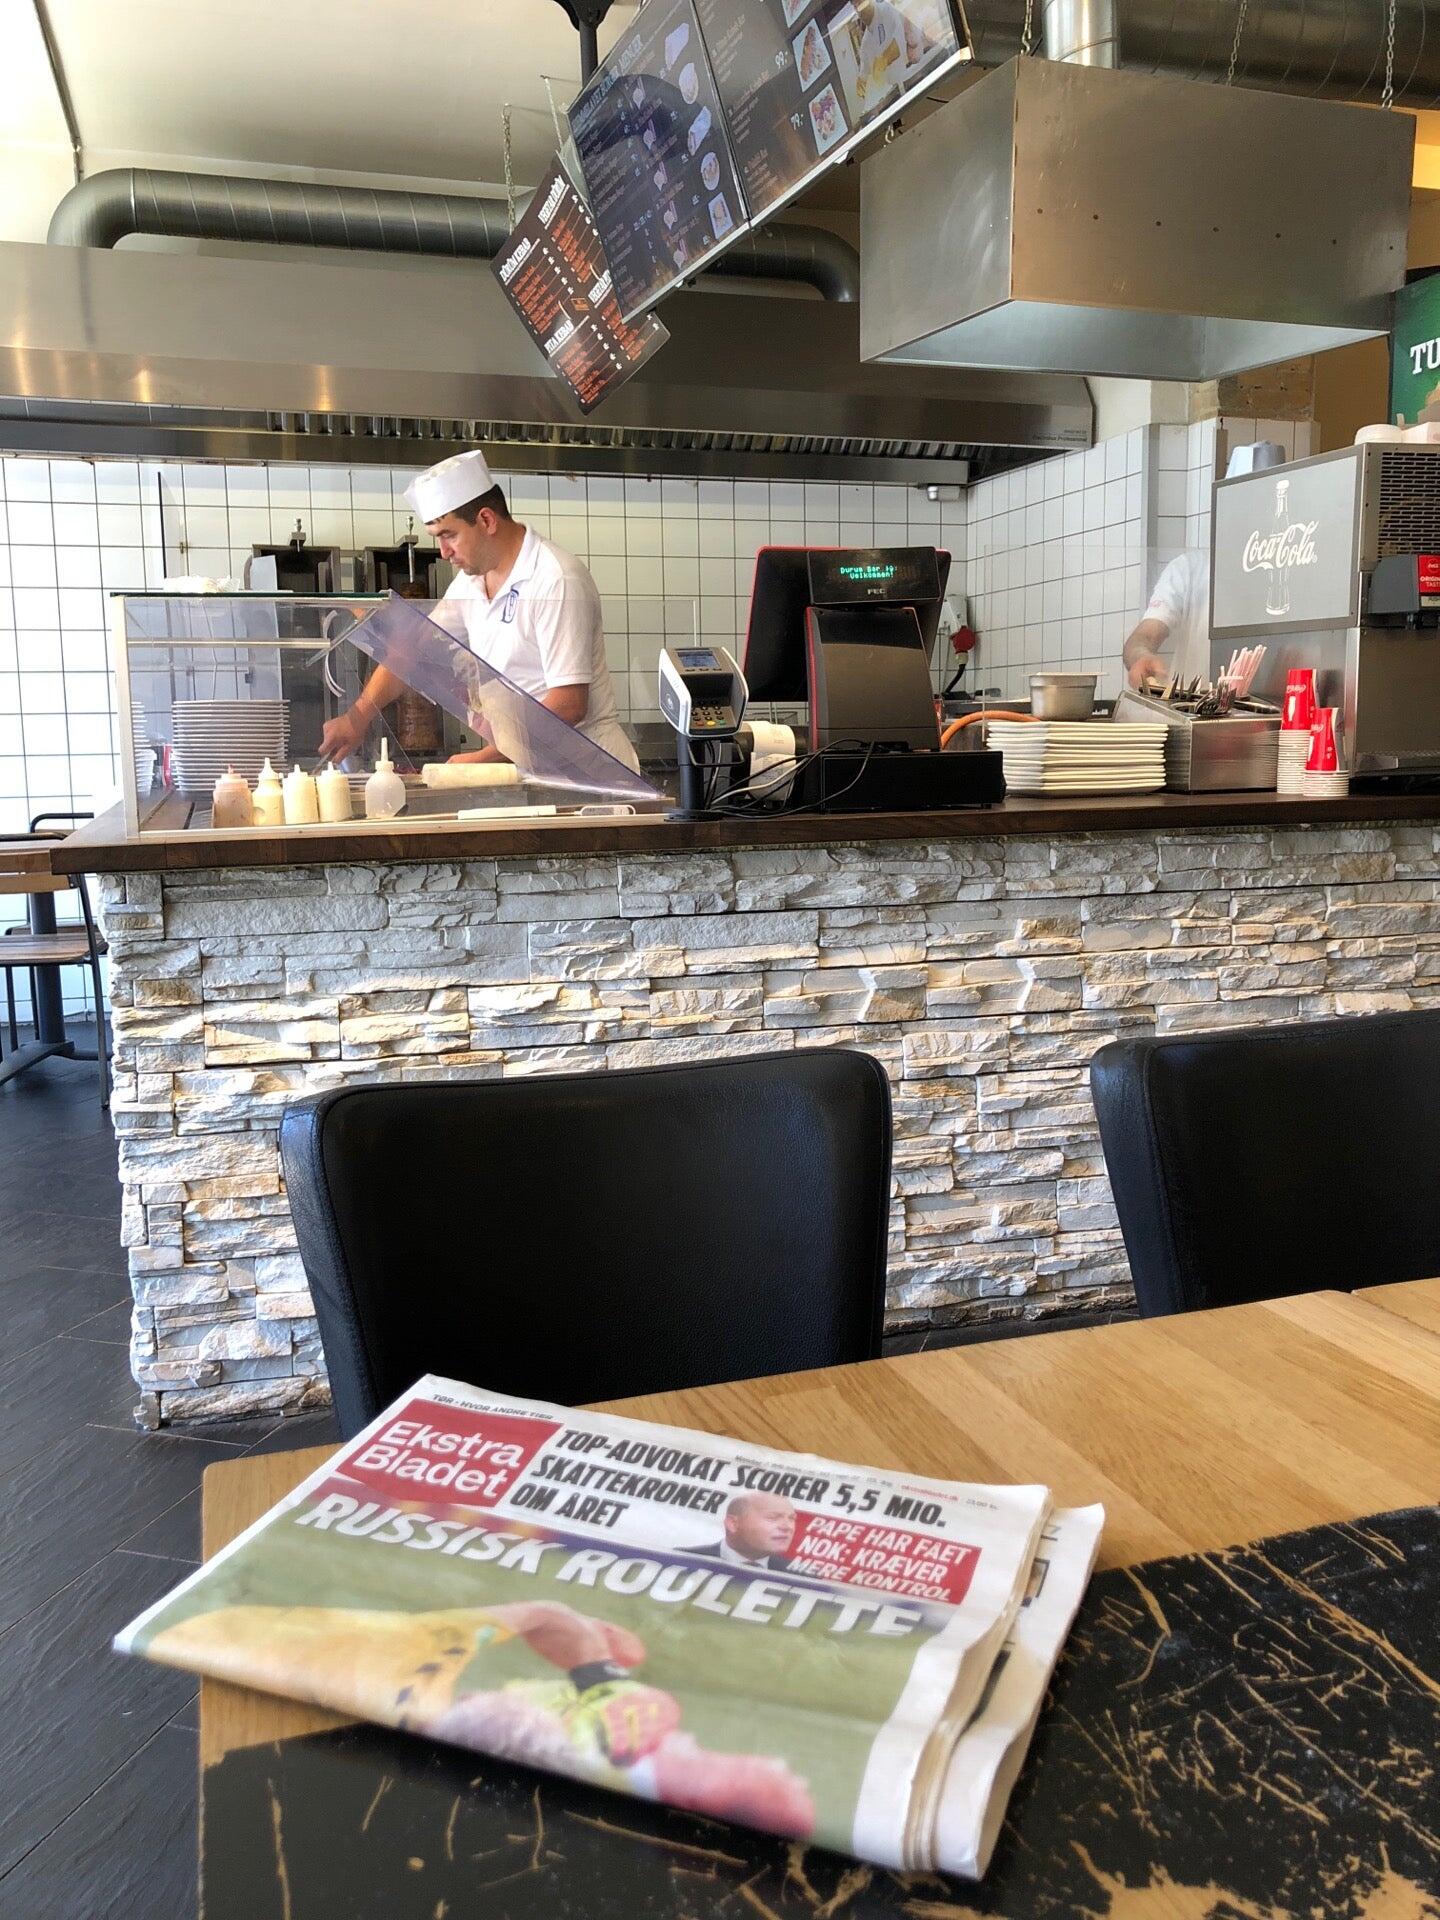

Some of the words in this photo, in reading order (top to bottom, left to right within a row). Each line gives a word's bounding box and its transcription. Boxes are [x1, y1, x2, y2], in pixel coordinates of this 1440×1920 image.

[1243, 520, 1319, 572] Coca-Cola
[460, 1400, 490, 1411] HVOR
[490, 1406, 527, 1416] ANDRE
[529, 1411, 554, 1420] TIER
[379, 1420, 524, 1468] Ekstra
[353, 1443, 508, 1498] Bladet
[531, 1454, 729, 1514] SKATTEKRONER
[555, 1429, 731, 1482] TOP-ADVOKAT
[729, 1464, 830, 1504] SCORER
[831, 1483, 880, 1514] 5,5
[884, 1494, 947, 1528] MIO.
[509, 1482, 559, 1512] OM
[555, 1492, 630, 1528] ÅRET
[796, 1535, 850, 1563] NOK:
[851, 1547, 949, 1584] KRÆVER
[806, 1516, 865, 1543] PAPE
[863, 1528, 913, 1557] HAR
[294, 1492, 567, 1574] RUSSISK
[555, 1548, 923, 1637] ROULETTE
[786, 1556, 851, 1581] MERE
[849, 1570, 951, 1601] KONTROL
